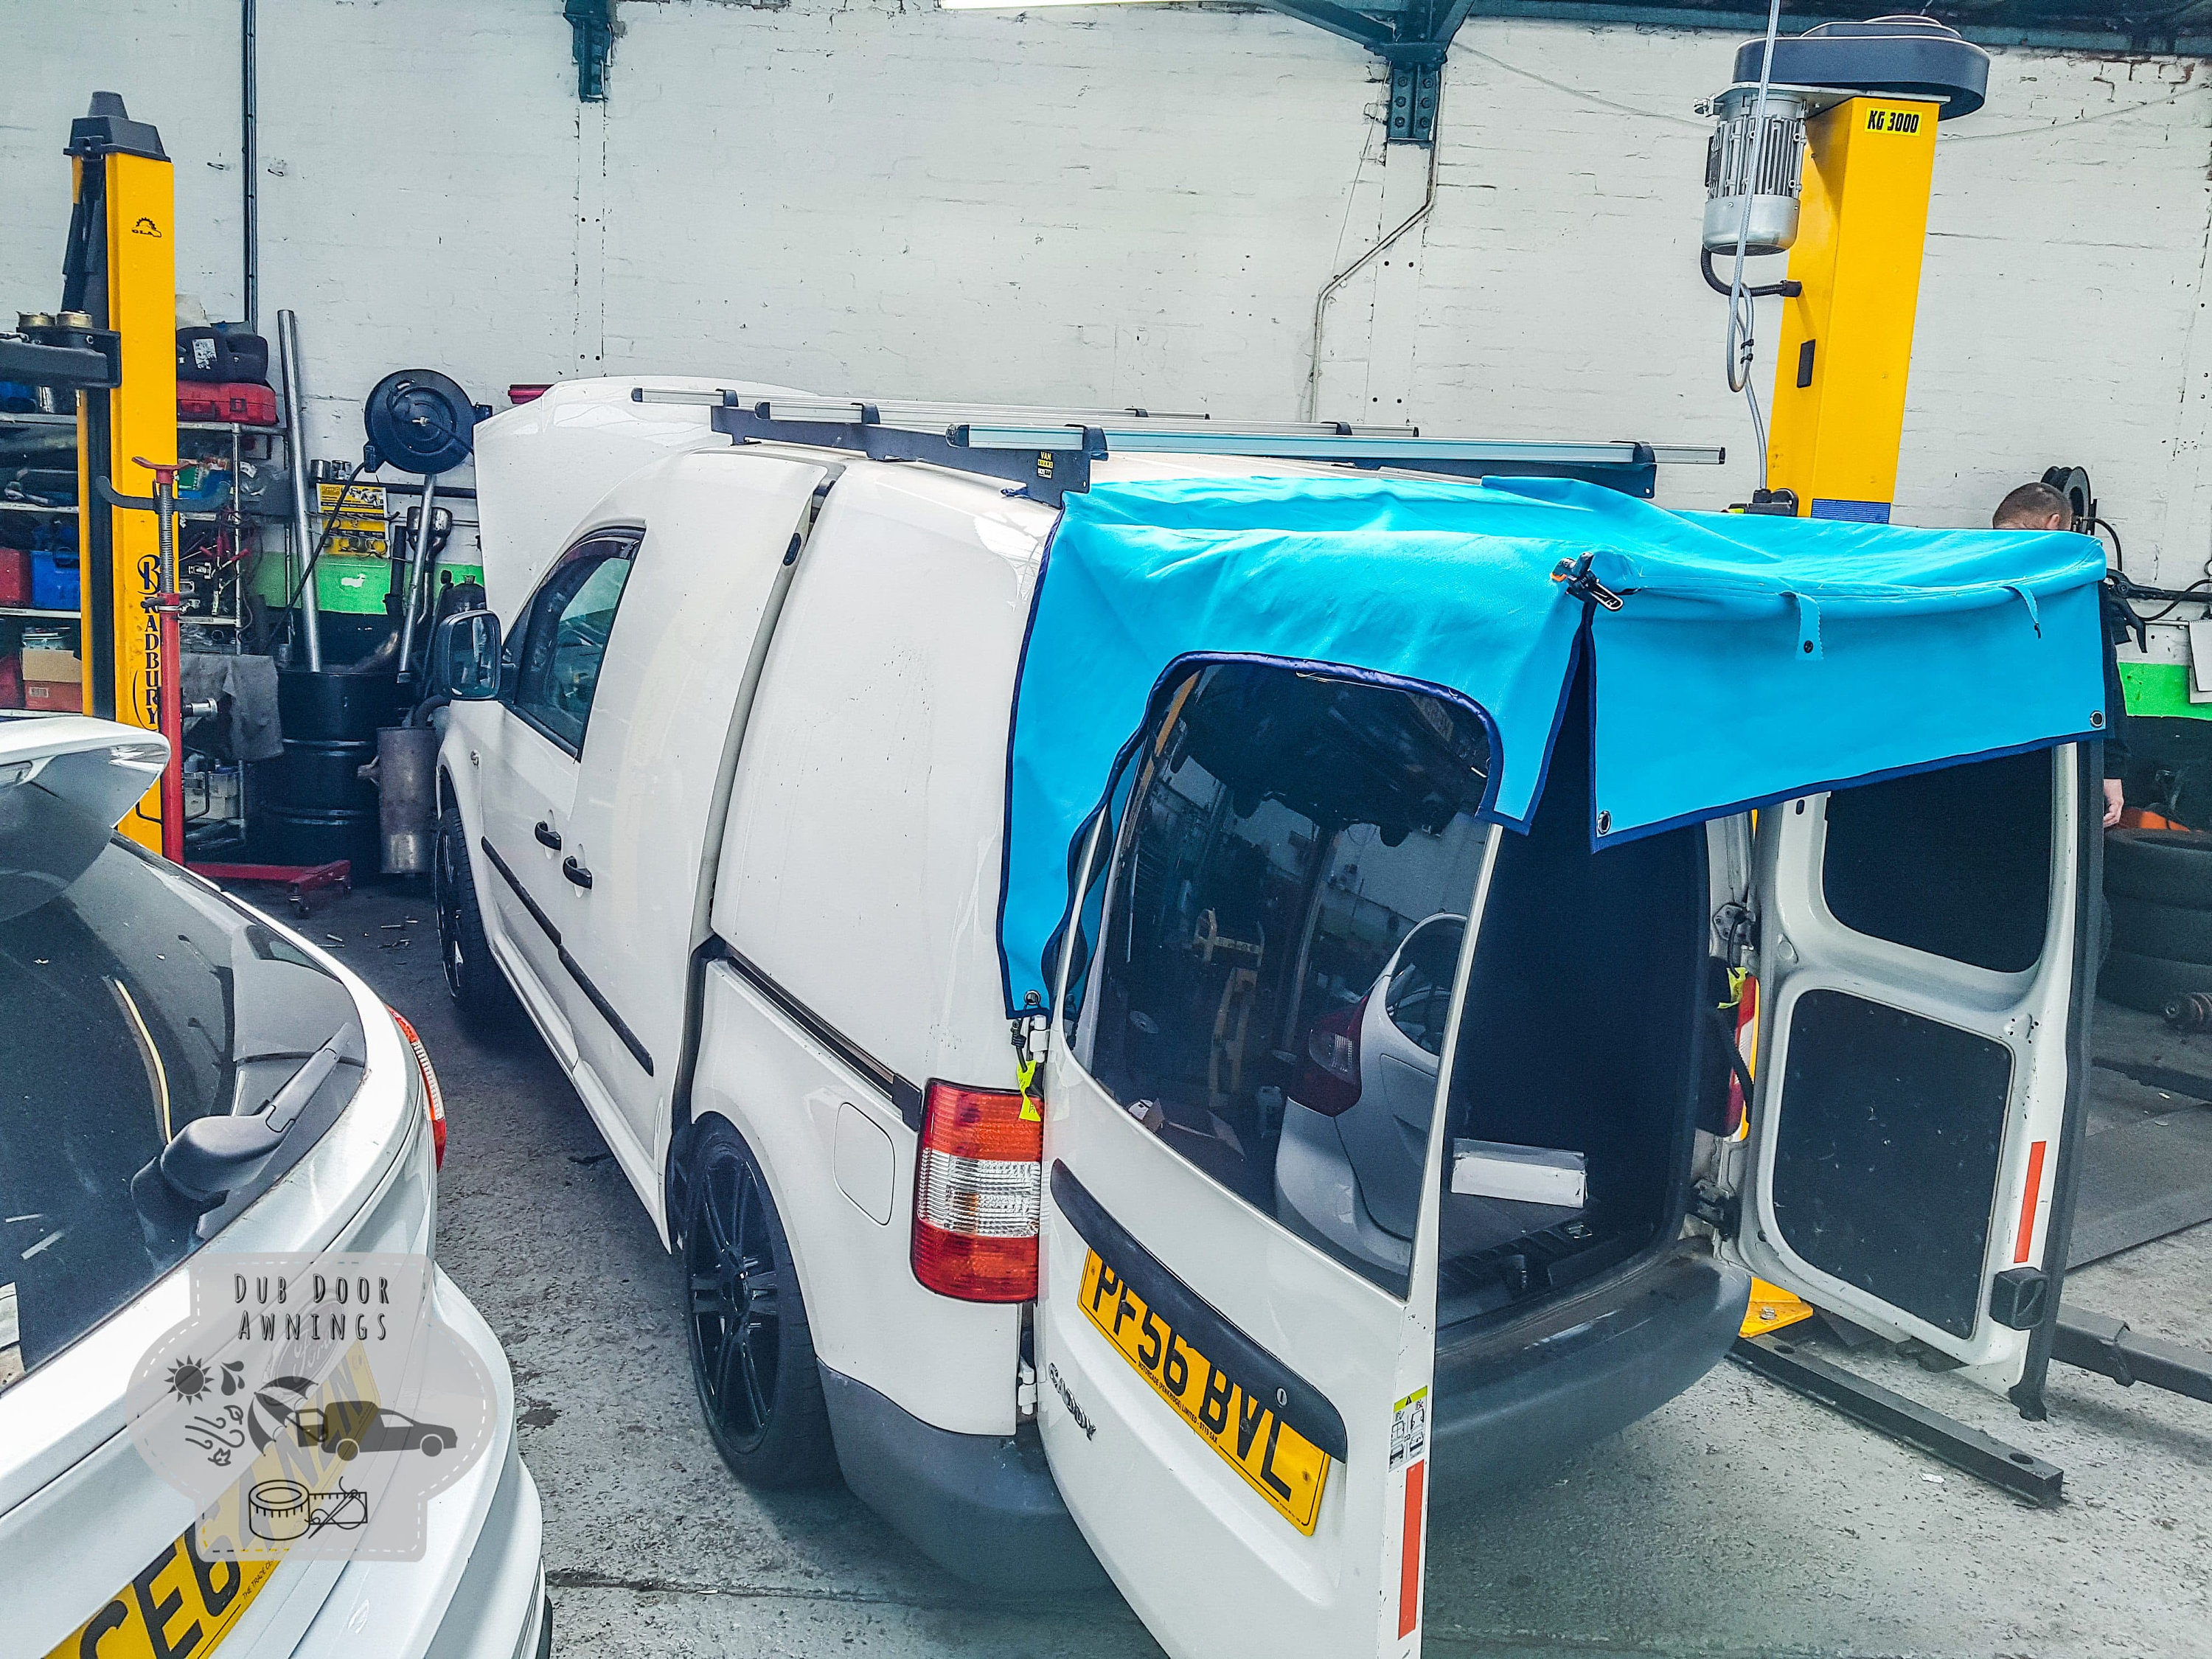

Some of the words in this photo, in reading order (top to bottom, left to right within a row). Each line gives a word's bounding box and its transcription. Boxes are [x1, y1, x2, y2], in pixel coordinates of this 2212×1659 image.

[1867, 110, 1885, 131] KG
[1887, 112, 1920, 133] 3000
[1040, 451, 1051, 461] VAN
[1093, 1262, 1189, 1397] PF56
[1198, 1363, 1292, 1502] BVL
[1138, 1360, 1159, 1386] MOTORCADE
[1181, 1404, 1197, 1424] LIMITED
